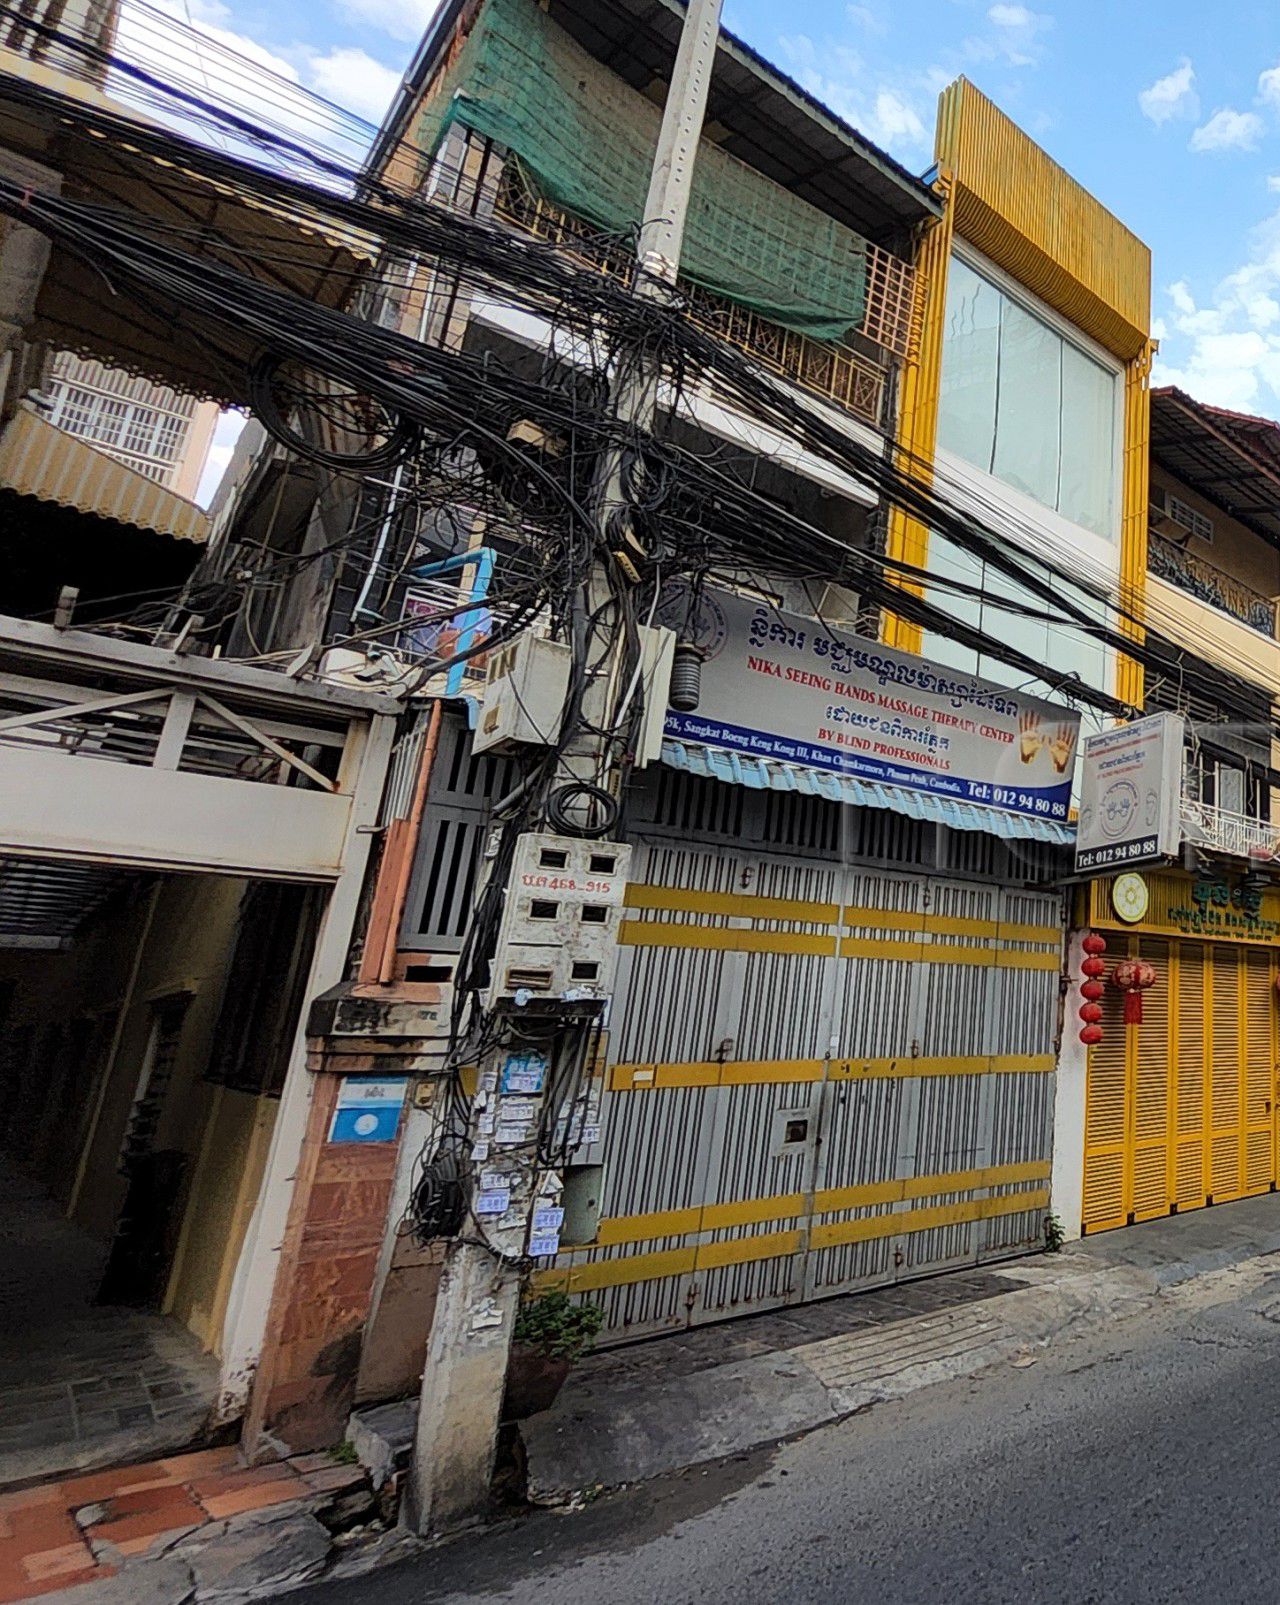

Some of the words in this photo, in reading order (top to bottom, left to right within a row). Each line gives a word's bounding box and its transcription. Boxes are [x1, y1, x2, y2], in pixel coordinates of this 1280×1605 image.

[747, 655, 782, 679] NIKA
[785, 666, 832, 692] SEEING
[834, 682, 876, 705] HANDS
[878, 693, 928, 719] MASSAGE
[931, 709, 979, 735] THERAPY
[979, 724, 1015, 744] CENTER
[683, 720, 721, 739] Sangkat
[817, 727, 835, 741] BY
[837, 732, 871, 750] BLIND
[873, 741, 951, 770] PROFESSIONALS
[966, 781, 991, 800] Tel:
[993, 787, 1016, 805] 012
[1018, 794, 1034, 809] 94
[1034, 799, 1051, 813] 80
[1051, 802, 1067, 816] 88
[1078, 854, 1095, 868] Tel:
[1095, 849, 1115, 864] 012
[1115, 847, 1128, 860] 94
[1128, 843, 1142, 857] 80
[1142, 840, 1156, 854] 88
